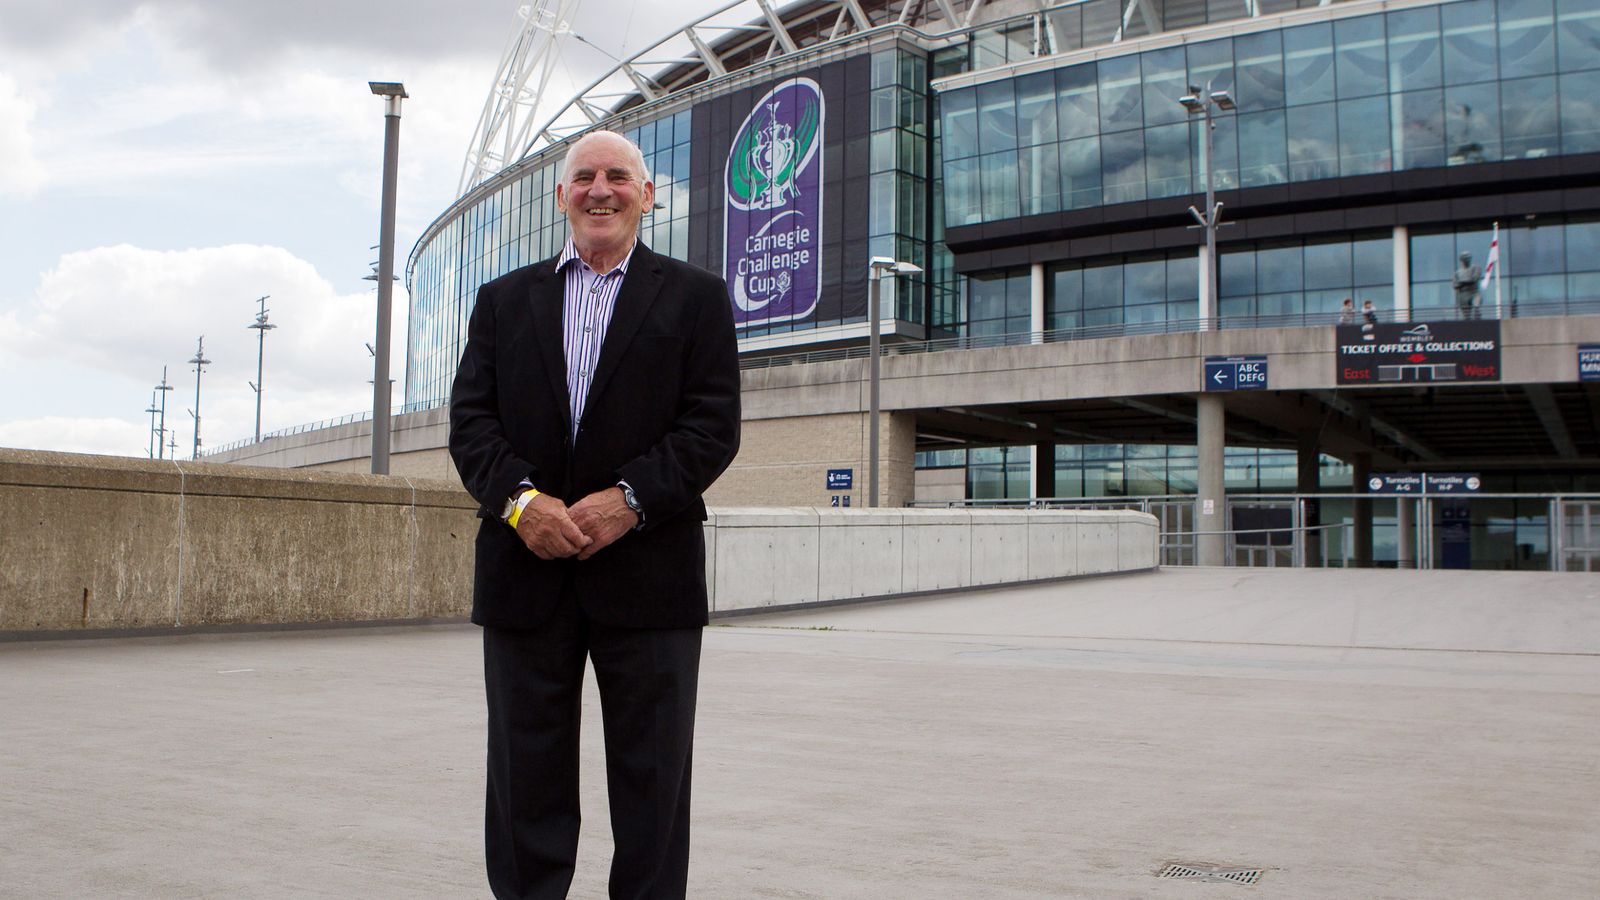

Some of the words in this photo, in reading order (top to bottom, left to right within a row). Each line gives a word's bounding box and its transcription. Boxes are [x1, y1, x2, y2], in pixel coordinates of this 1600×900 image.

[746, 225, 810, 253] Carnegie
[737, 249, 810, 276] Challenge
[749, 276, 776, 295] Cup
[1342, 344, 1376, 354] TICKET
[1379, 343, 1413, 353] OFFICE
[1415, 343, 1424, 352] &
[1425, 341, 1495, 351] COLLECTIONS
[1239, 363, 1260, 372] ABC
[1344, 368, 1370, 379] East
[1463, 364, 1495, 376] West
[1239, 373, 1265, 382] DEFG
[1385, 476, 1420, 484] Turnstiles
[1428, 476, 1463, 484] Turnstiles
